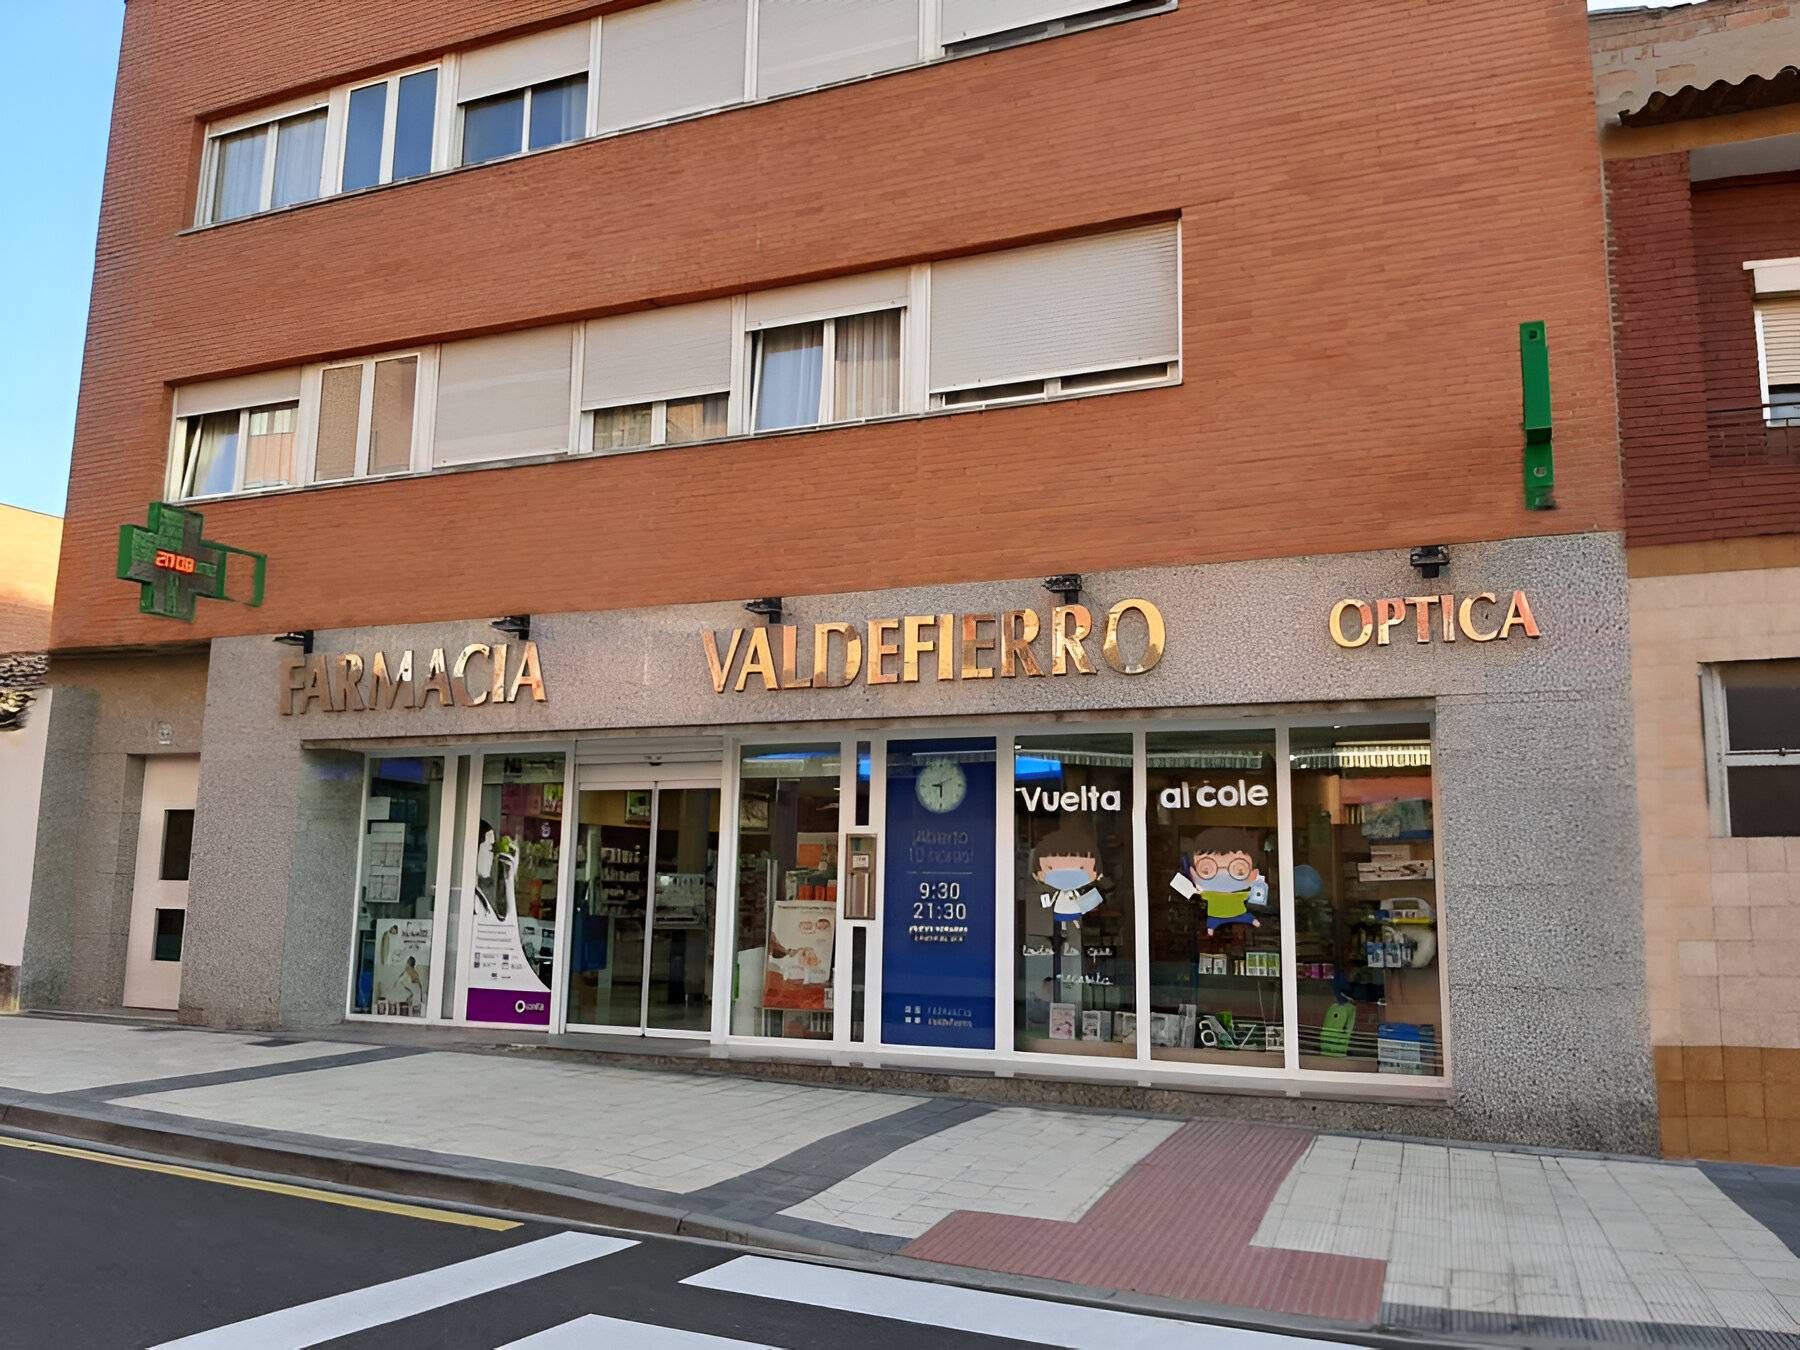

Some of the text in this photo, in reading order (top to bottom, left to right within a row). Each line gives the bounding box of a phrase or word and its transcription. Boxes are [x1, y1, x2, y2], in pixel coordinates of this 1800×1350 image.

[278, 590, 1542, 716] FARMACIA VALDEFIERRO OPTICA
[1020, 779, 1269, 812] Vuelta al cole
[919, 882, 960, 900] 9:30
[913, 902, 967, 920] 21:30
